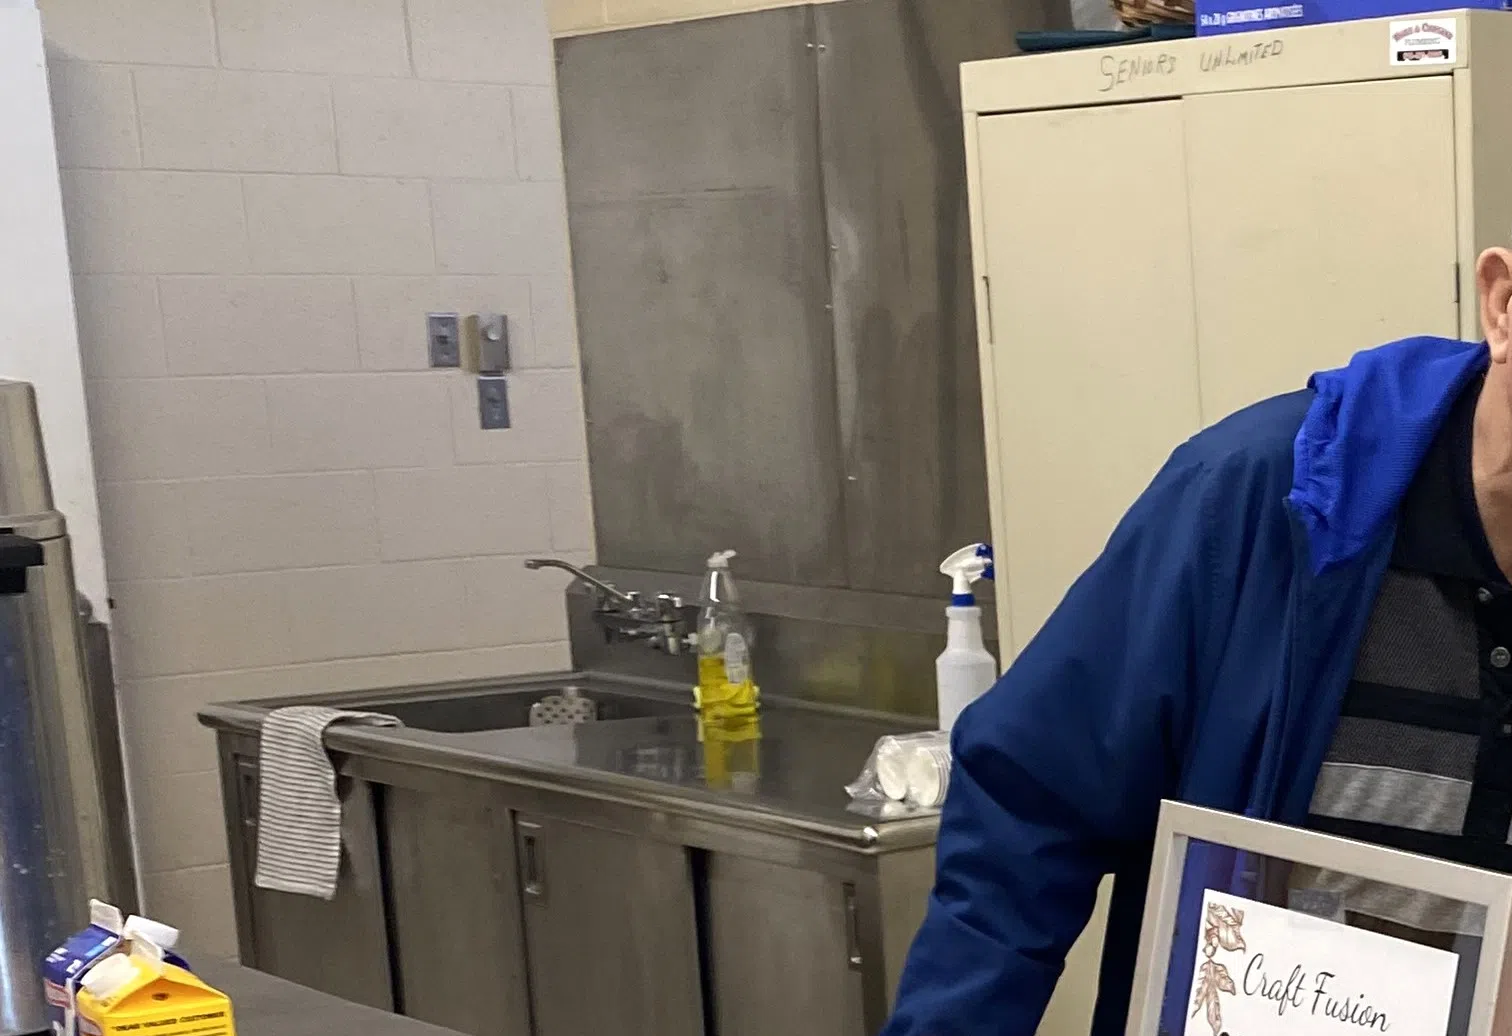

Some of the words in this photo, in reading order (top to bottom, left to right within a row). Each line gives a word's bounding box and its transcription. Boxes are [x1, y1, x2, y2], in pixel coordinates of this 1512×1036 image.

[1098, 53, 1176, 92] SENIORS
[1243, 953, 1307, 1016] Craft
[1311, 971, 1393, 1032] Fusion
